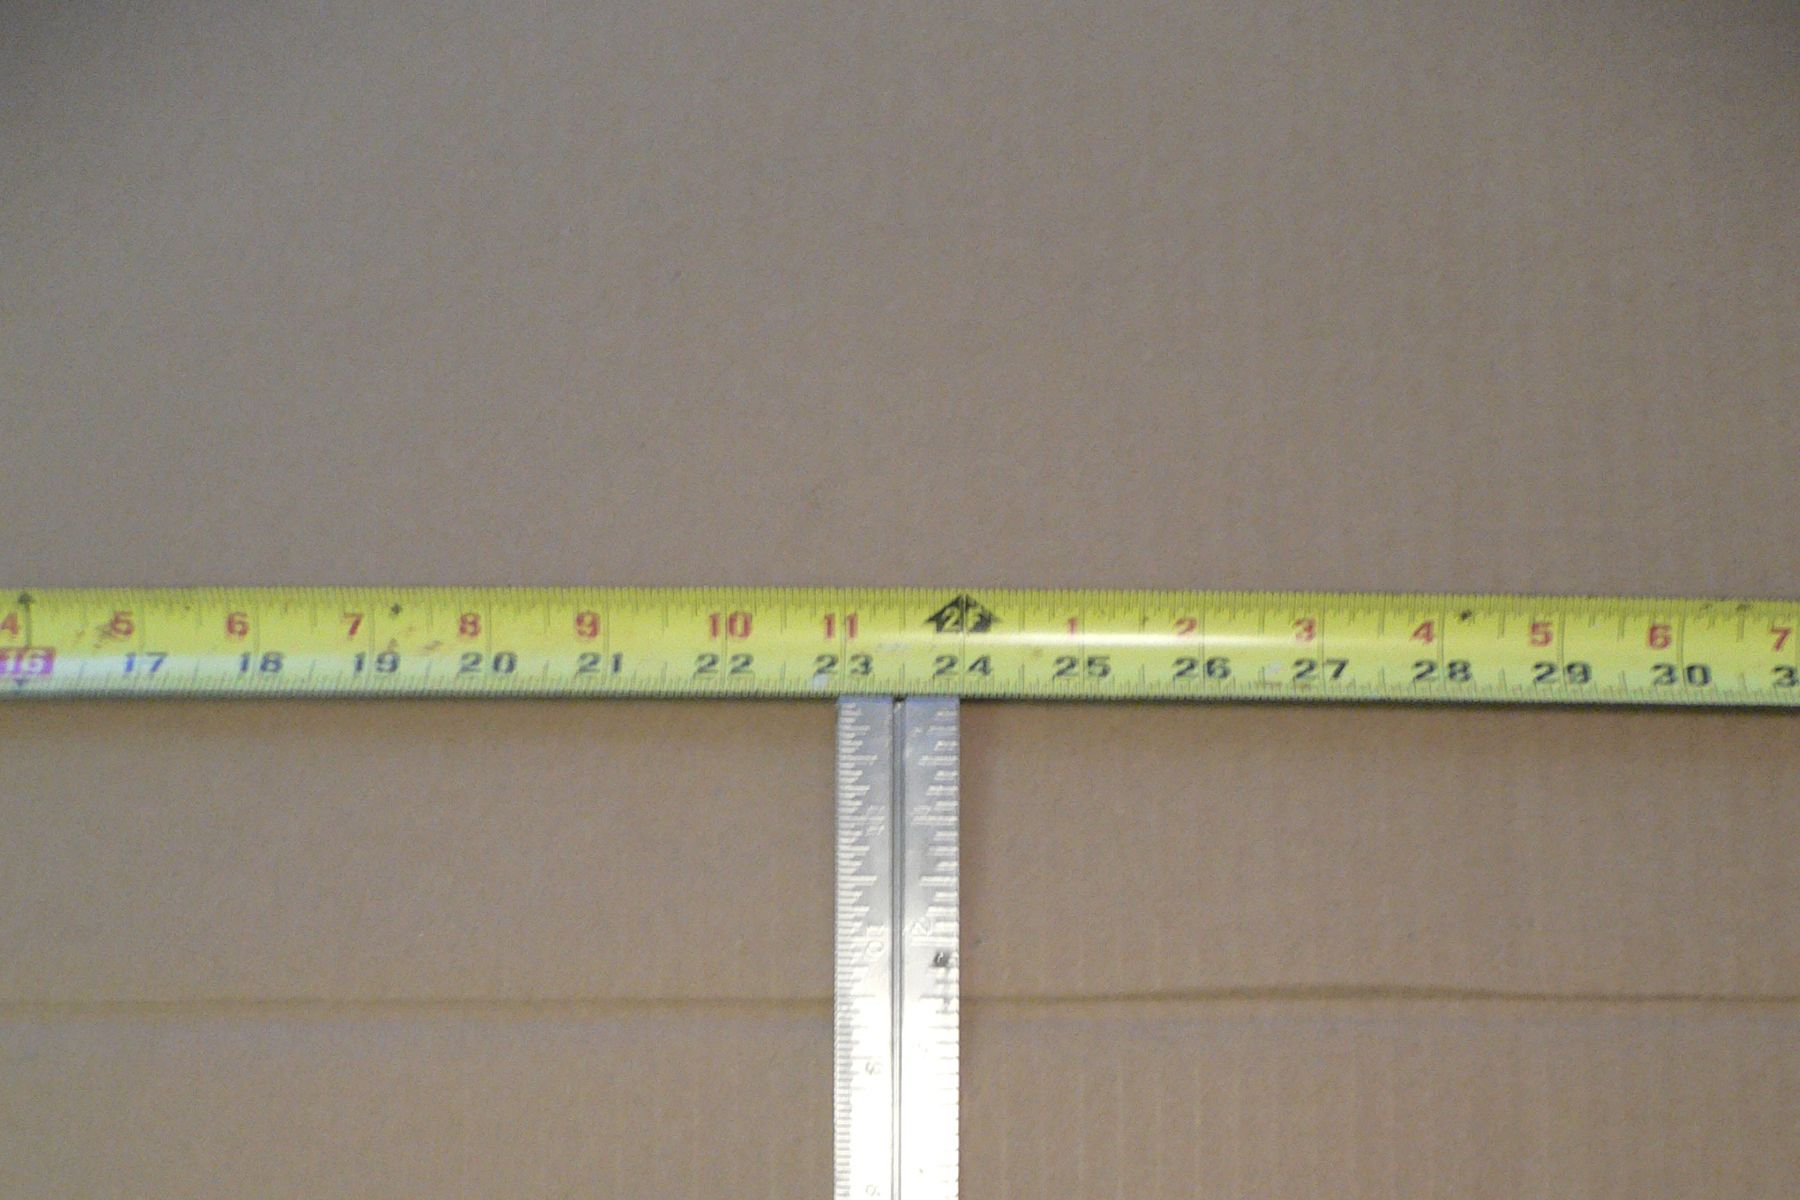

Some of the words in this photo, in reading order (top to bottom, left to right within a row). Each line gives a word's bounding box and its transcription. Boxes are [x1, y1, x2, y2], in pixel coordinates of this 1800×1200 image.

[0, 612, 18, 635] 4
[110, 611, 134, 635] 5
[227, 612, 249, 636] 6
[345, 612, 364, 635] 7
[459, 612, 481, 636] 8
[576, 612, 599, 638] 9
[709, 612, 753, 638] 10
[824, 613, 858, 639] 11
[1067, 617, 1079, 634] 1
[1174, 617, 1197, 636] 2
[1294, 617, 1316, 641] 3
[1411, 620, 1434, 643] 4
[1530, 622, 1552, 646] 5
[1648, 624, 1670, 648] 6
[1770, 626, 1792, 651] 7
[124, 652, 167, 672] 17
[241, 652, 283, 672] 18
[355, 652, 399, 673] 19
[460, 652, 517, 673] 20
[577, 652, 623, 673] 21
[697, 653, 754, 674] 22
[813, 654, 872, 675] 23
[935, 655, 992, 676] 24
[1055, 656, 1111, 677] 25
[1173, 657, 1230, 678] 26
[1294, 658, 1348, 679] 27
[1413, 660, 1472, 681] 28
[1533, 661, 1591, 684] 29
[1652, 663, 1711, 686] 30
